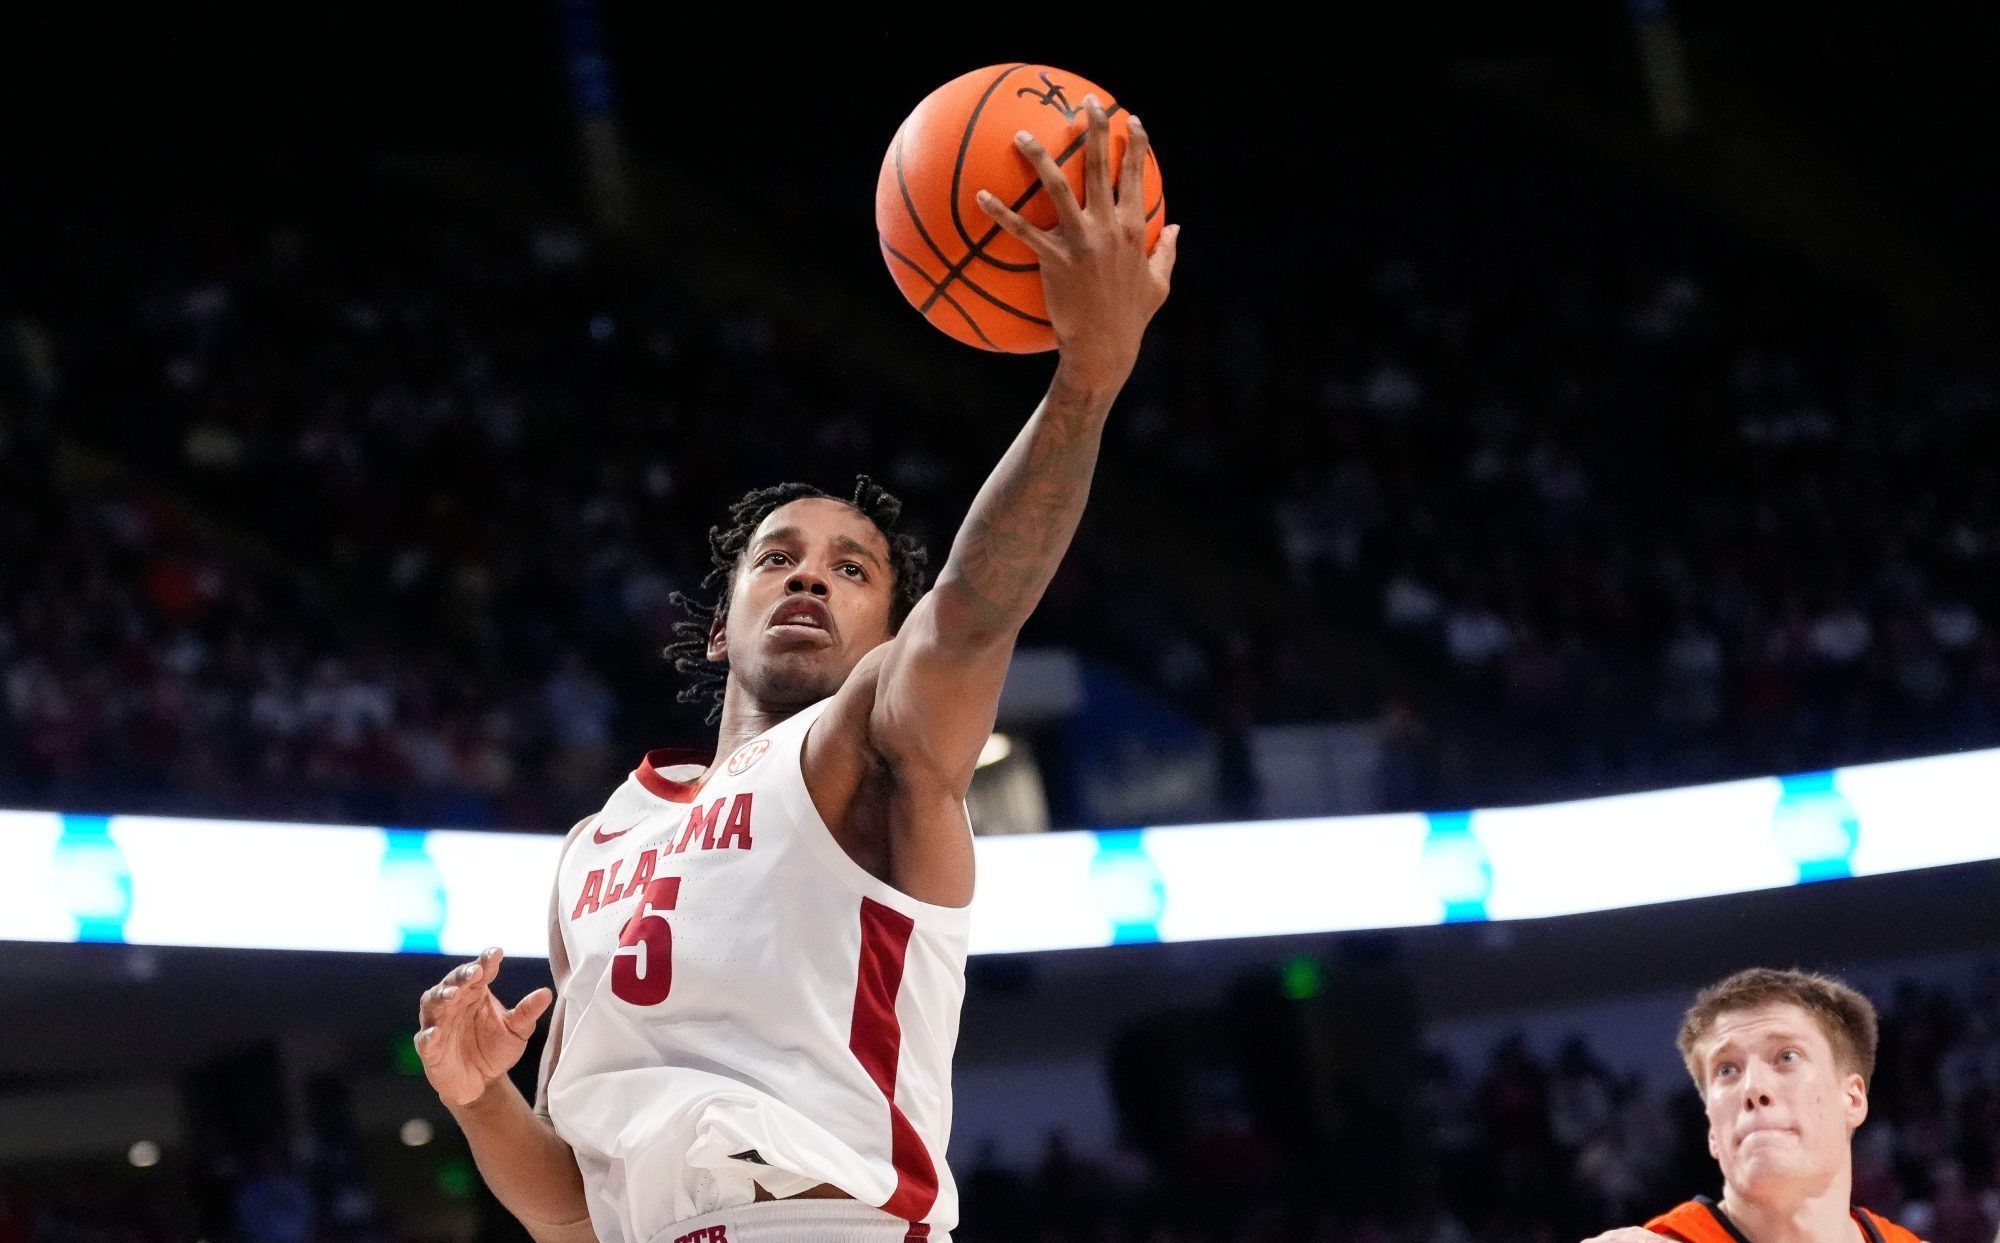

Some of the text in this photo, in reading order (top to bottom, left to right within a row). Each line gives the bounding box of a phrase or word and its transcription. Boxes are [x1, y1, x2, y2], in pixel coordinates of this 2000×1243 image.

[571, 793, 752, 921] ALAMA
[611, 877, 681, 1006] 5
[674, 1224, 729, 1243] TR
